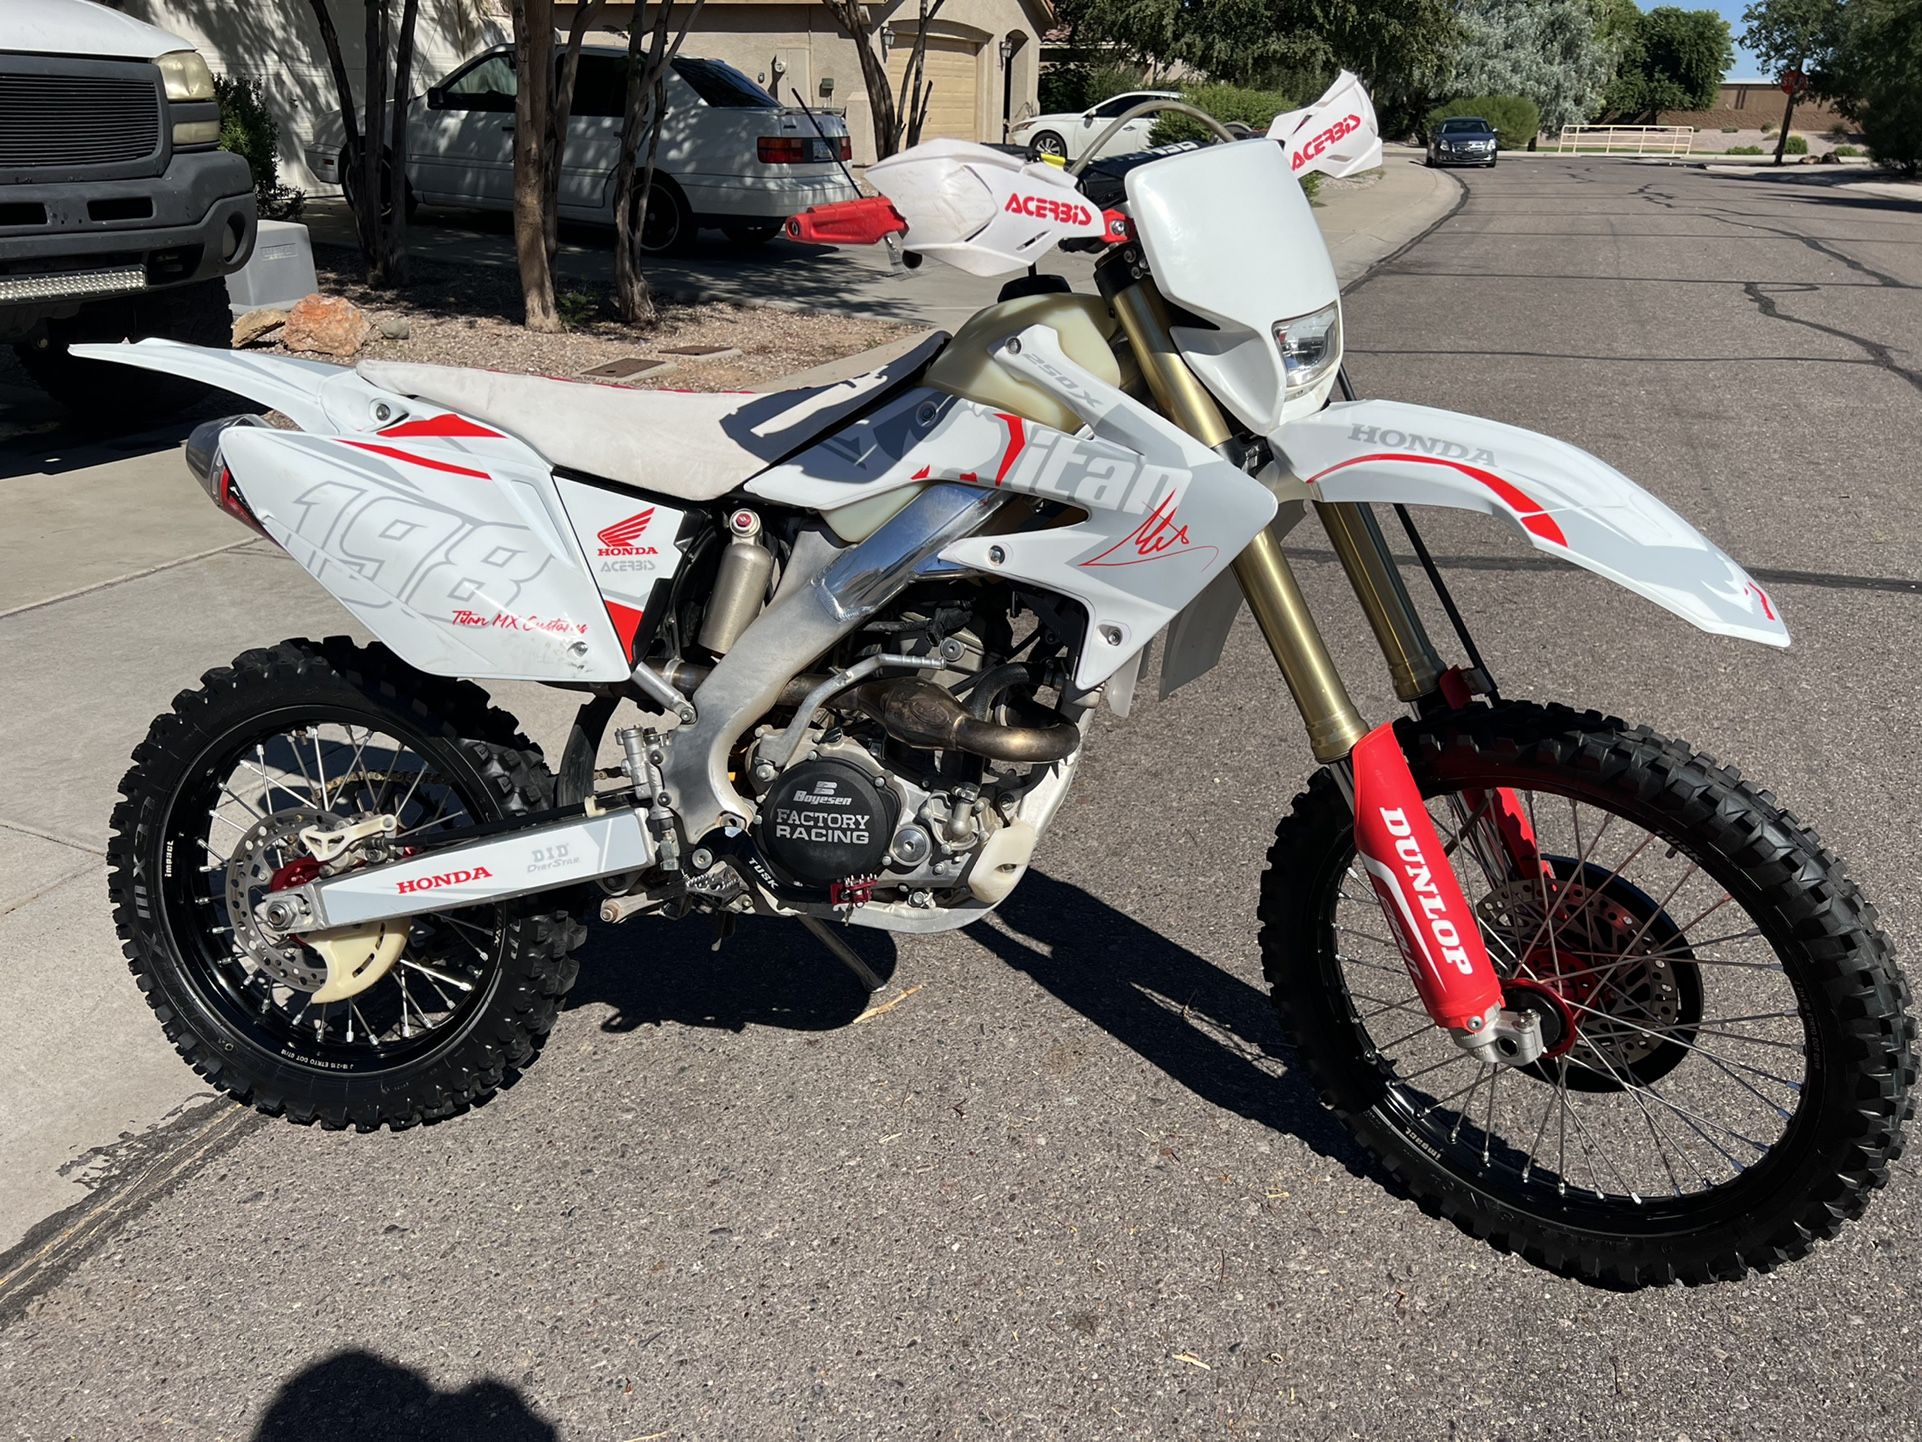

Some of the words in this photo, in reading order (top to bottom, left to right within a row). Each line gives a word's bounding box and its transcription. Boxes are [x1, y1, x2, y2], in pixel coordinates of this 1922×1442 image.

[1023, 353, 1104, 409] 250X
[1347, 423, 1498, 468] HONDA
[286, 481, 556, 630] 198
[597, 547, 659, 557] HONDA
[452, 610, 489, 627] Titan
[492, 613, 519, 630] MX
[793, 790, 852, 806] Boyesen
[776, 808, 870, 830] FACTORY
[776, 824, 870, 844] RACING
[164, 840, 174, 877] impact
[748, 857, 779, 890] TUSK
[396, 866, 493, 894] HONDA
[1379, 806, 1473, 975] DUNLOP
[1405, 1126, 1442, 1161] impact
